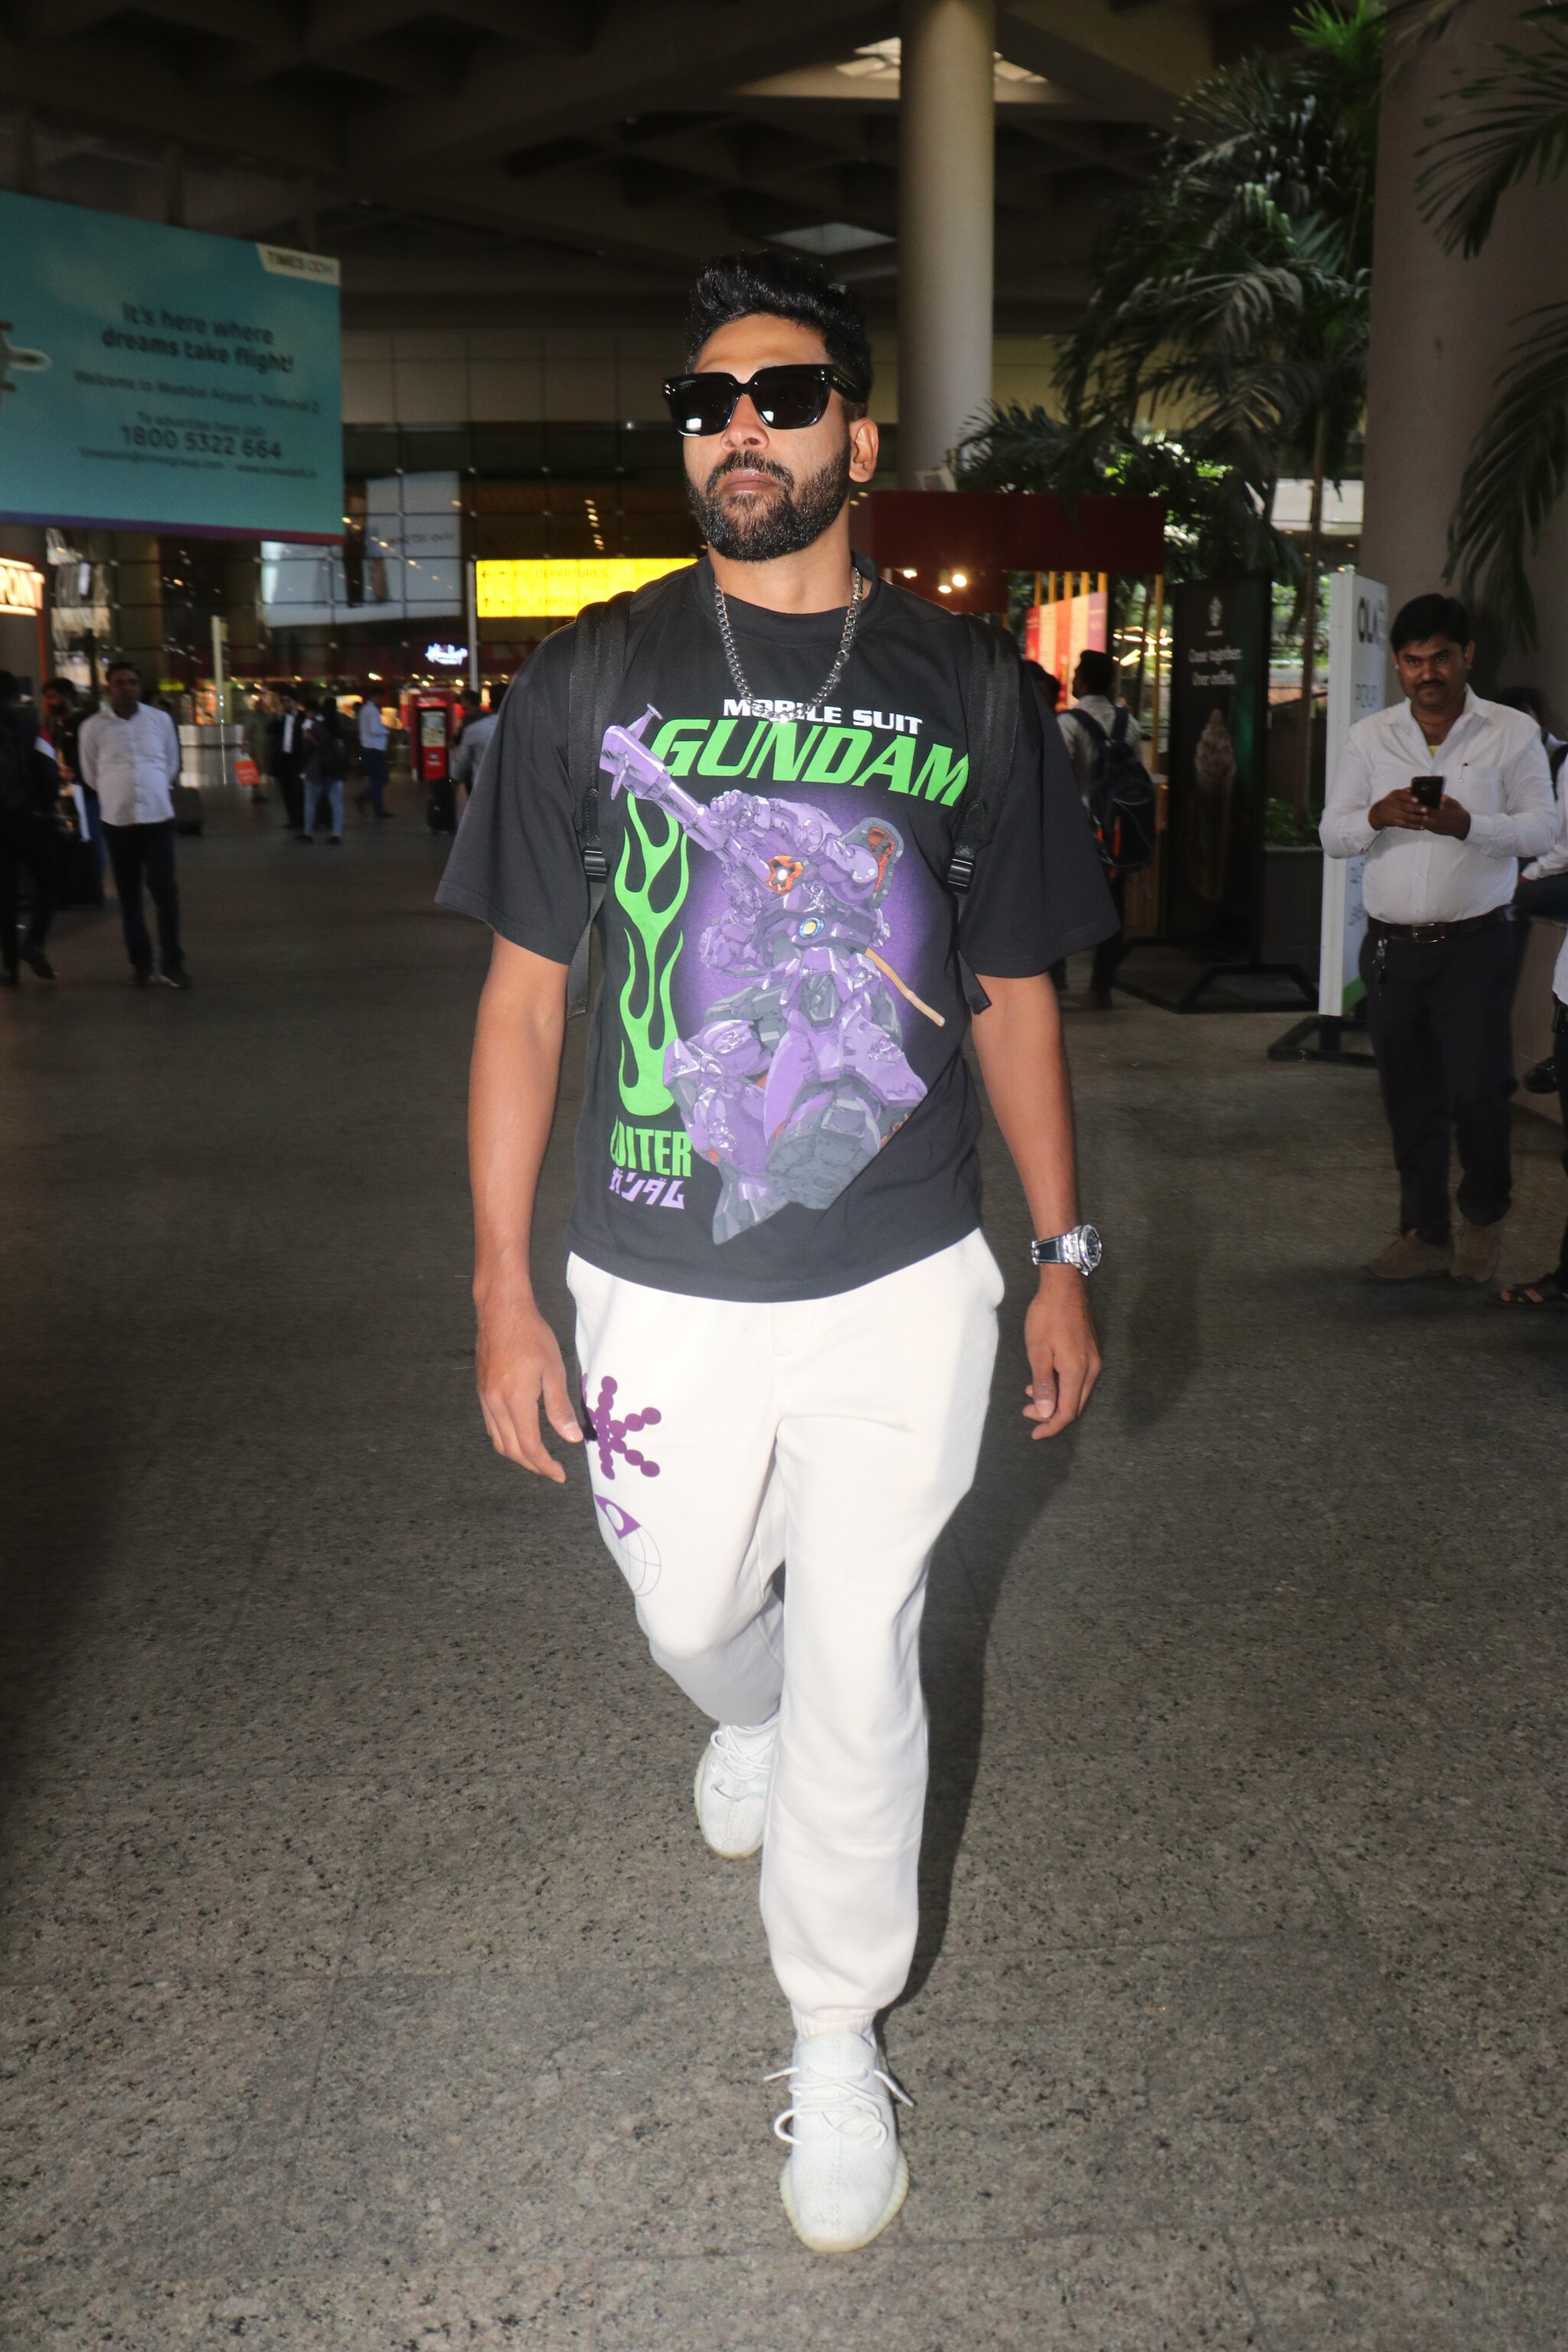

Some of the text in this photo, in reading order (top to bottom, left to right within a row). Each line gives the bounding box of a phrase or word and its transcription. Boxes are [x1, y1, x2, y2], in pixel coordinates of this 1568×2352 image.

[122, 302, 274, 345] It's here where
[101, 326, 179, 356] dreams
[183, 341, 229, 364] take
[121, 424, 177, 449] 1800
[184, 431, 234, 456] 5322
[241, 439, 283, 459] 664
[535, 568, 607, 578] DEPARTURES
[536, 596, 591, 606] ARRIVALS
[852, 709, 923, 735] SUIT
[649, 718, 970, 807] GUNDAM
